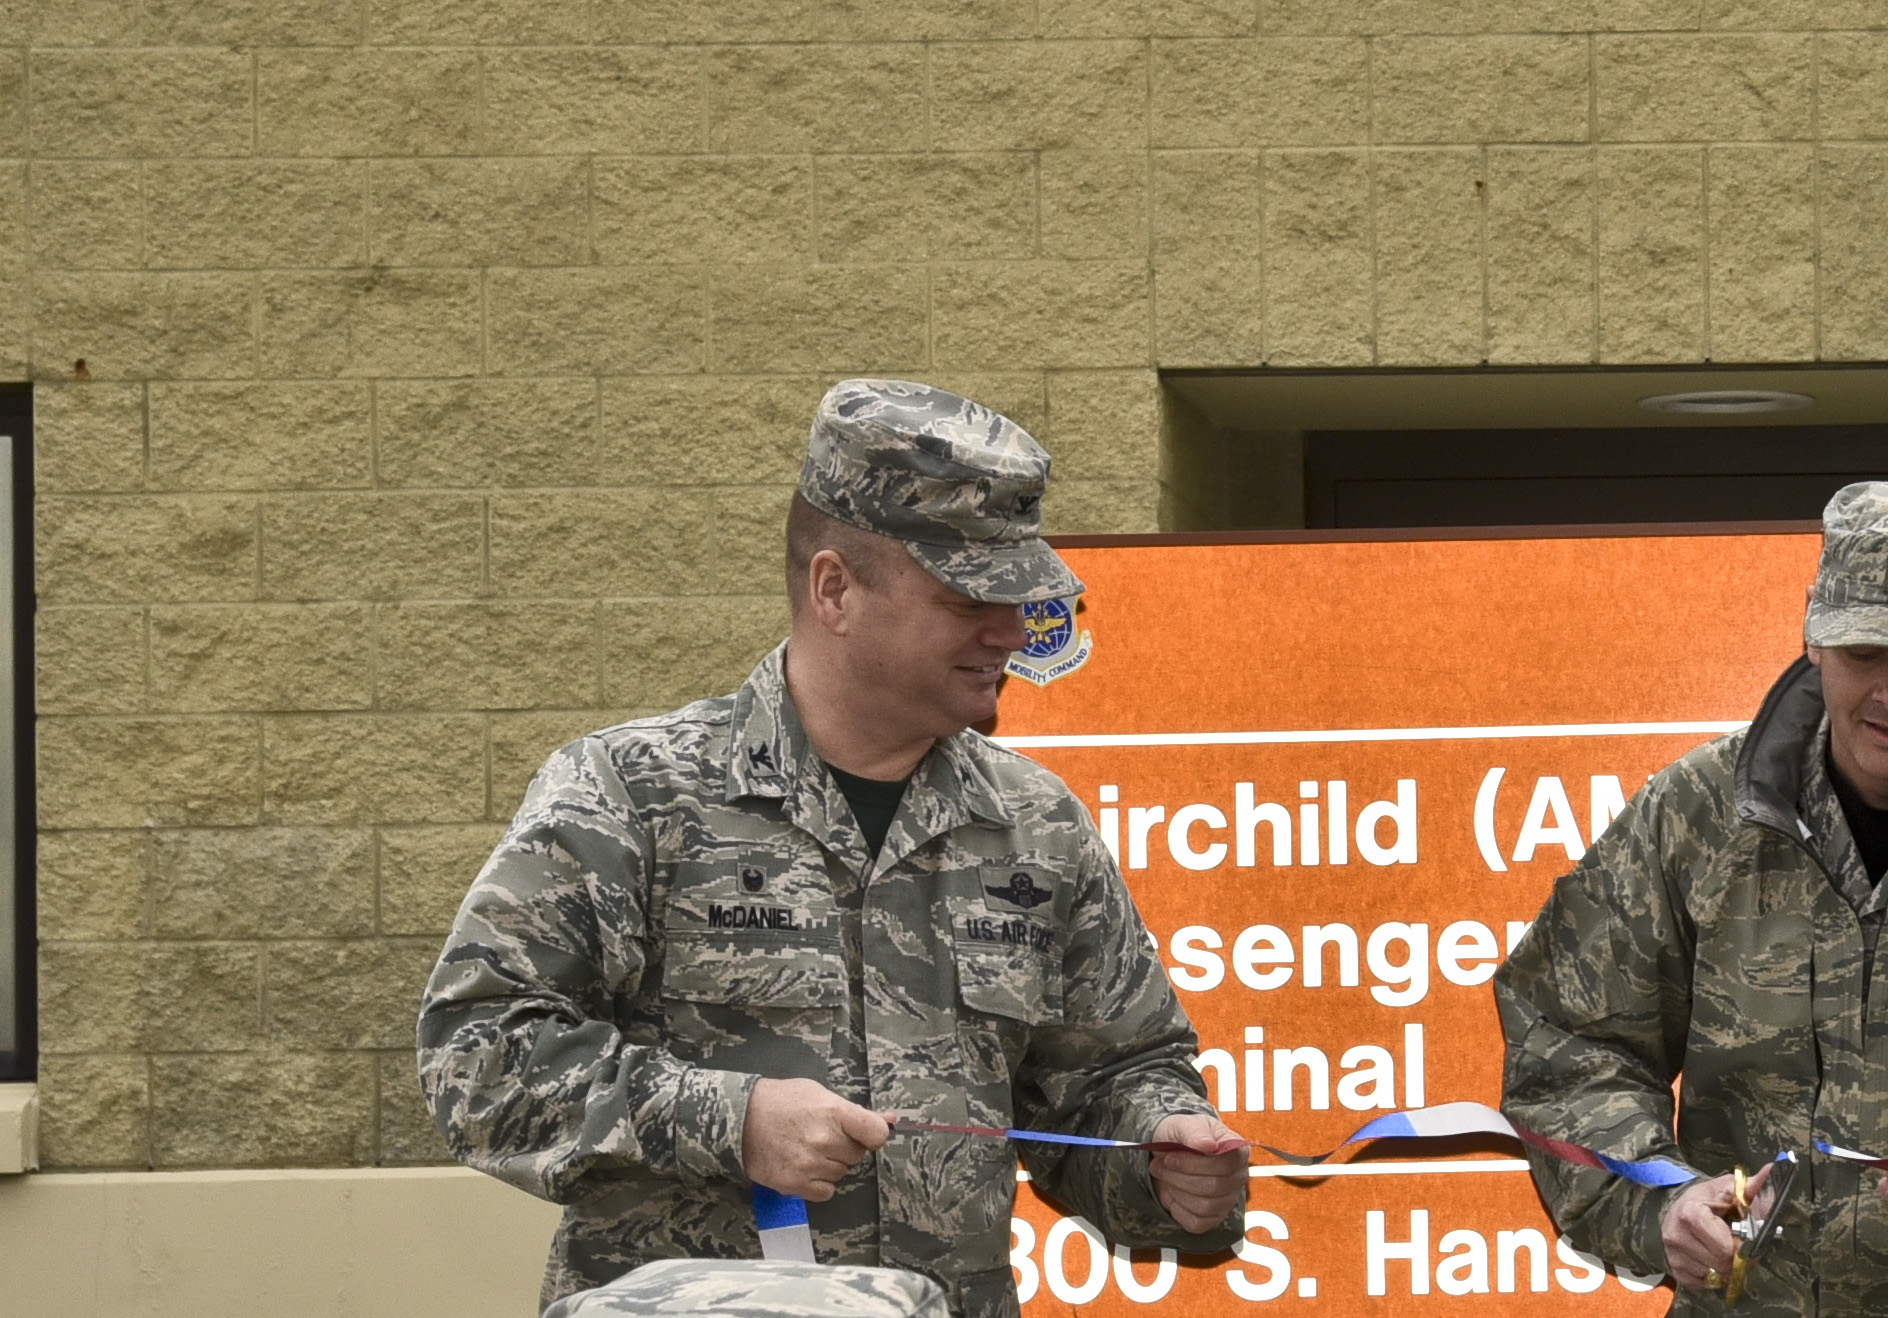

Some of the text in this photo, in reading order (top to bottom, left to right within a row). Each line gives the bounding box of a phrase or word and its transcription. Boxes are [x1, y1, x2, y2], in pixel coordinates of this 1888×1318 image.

[1008, 648, 1088, 683] MOBILITY COMMAND
[708, 904, 799, 931] McDANIEL
[1001, 920, 1028, 946] AIR
[1146, 920, 1534, 1007] senge
[1225, 1210, 1317, 1301] S.
[1365, 1208, 1666, 1296] Hans
